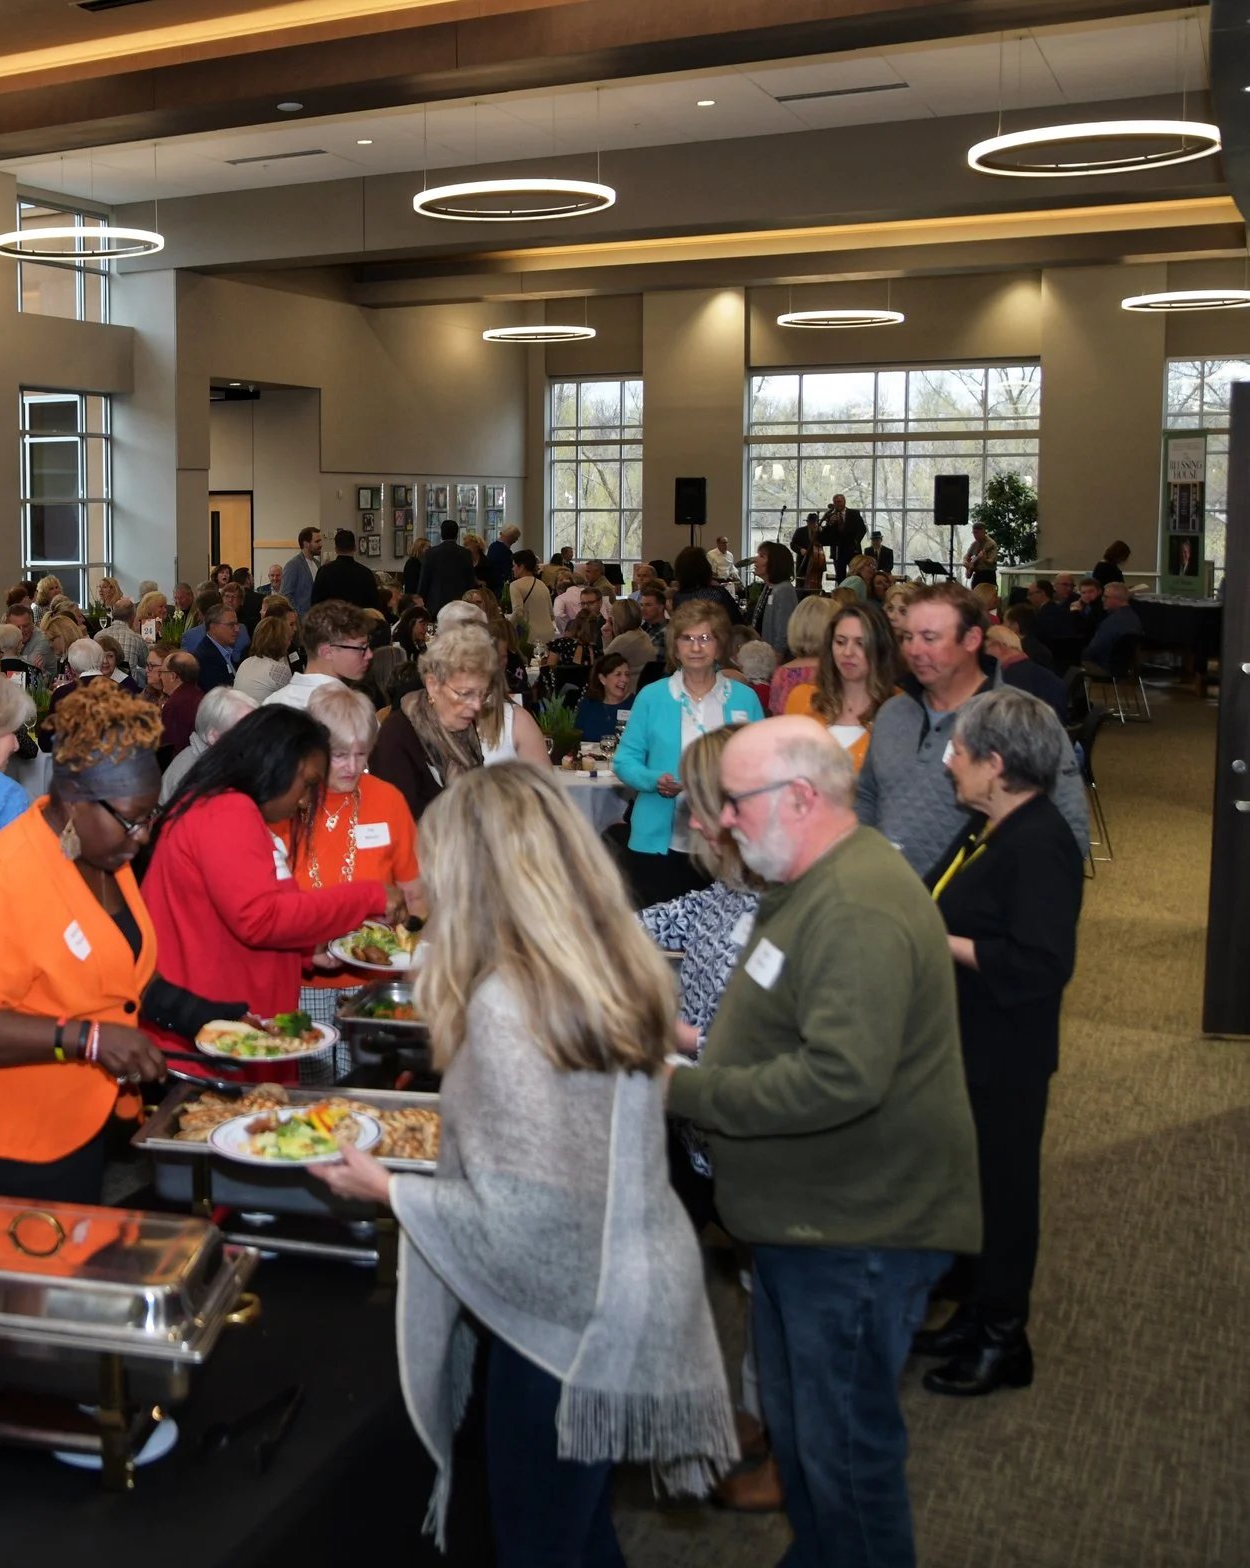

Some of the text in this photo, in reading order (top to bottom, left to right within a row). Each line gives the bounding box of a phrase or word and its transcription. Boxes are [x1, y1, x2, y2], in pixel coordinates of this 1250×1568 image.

[1169, 459, 1202, 470] BLESSING
[1173, 469, 1198, 479] HOUSE
[144, 627, 153, 635] 24
